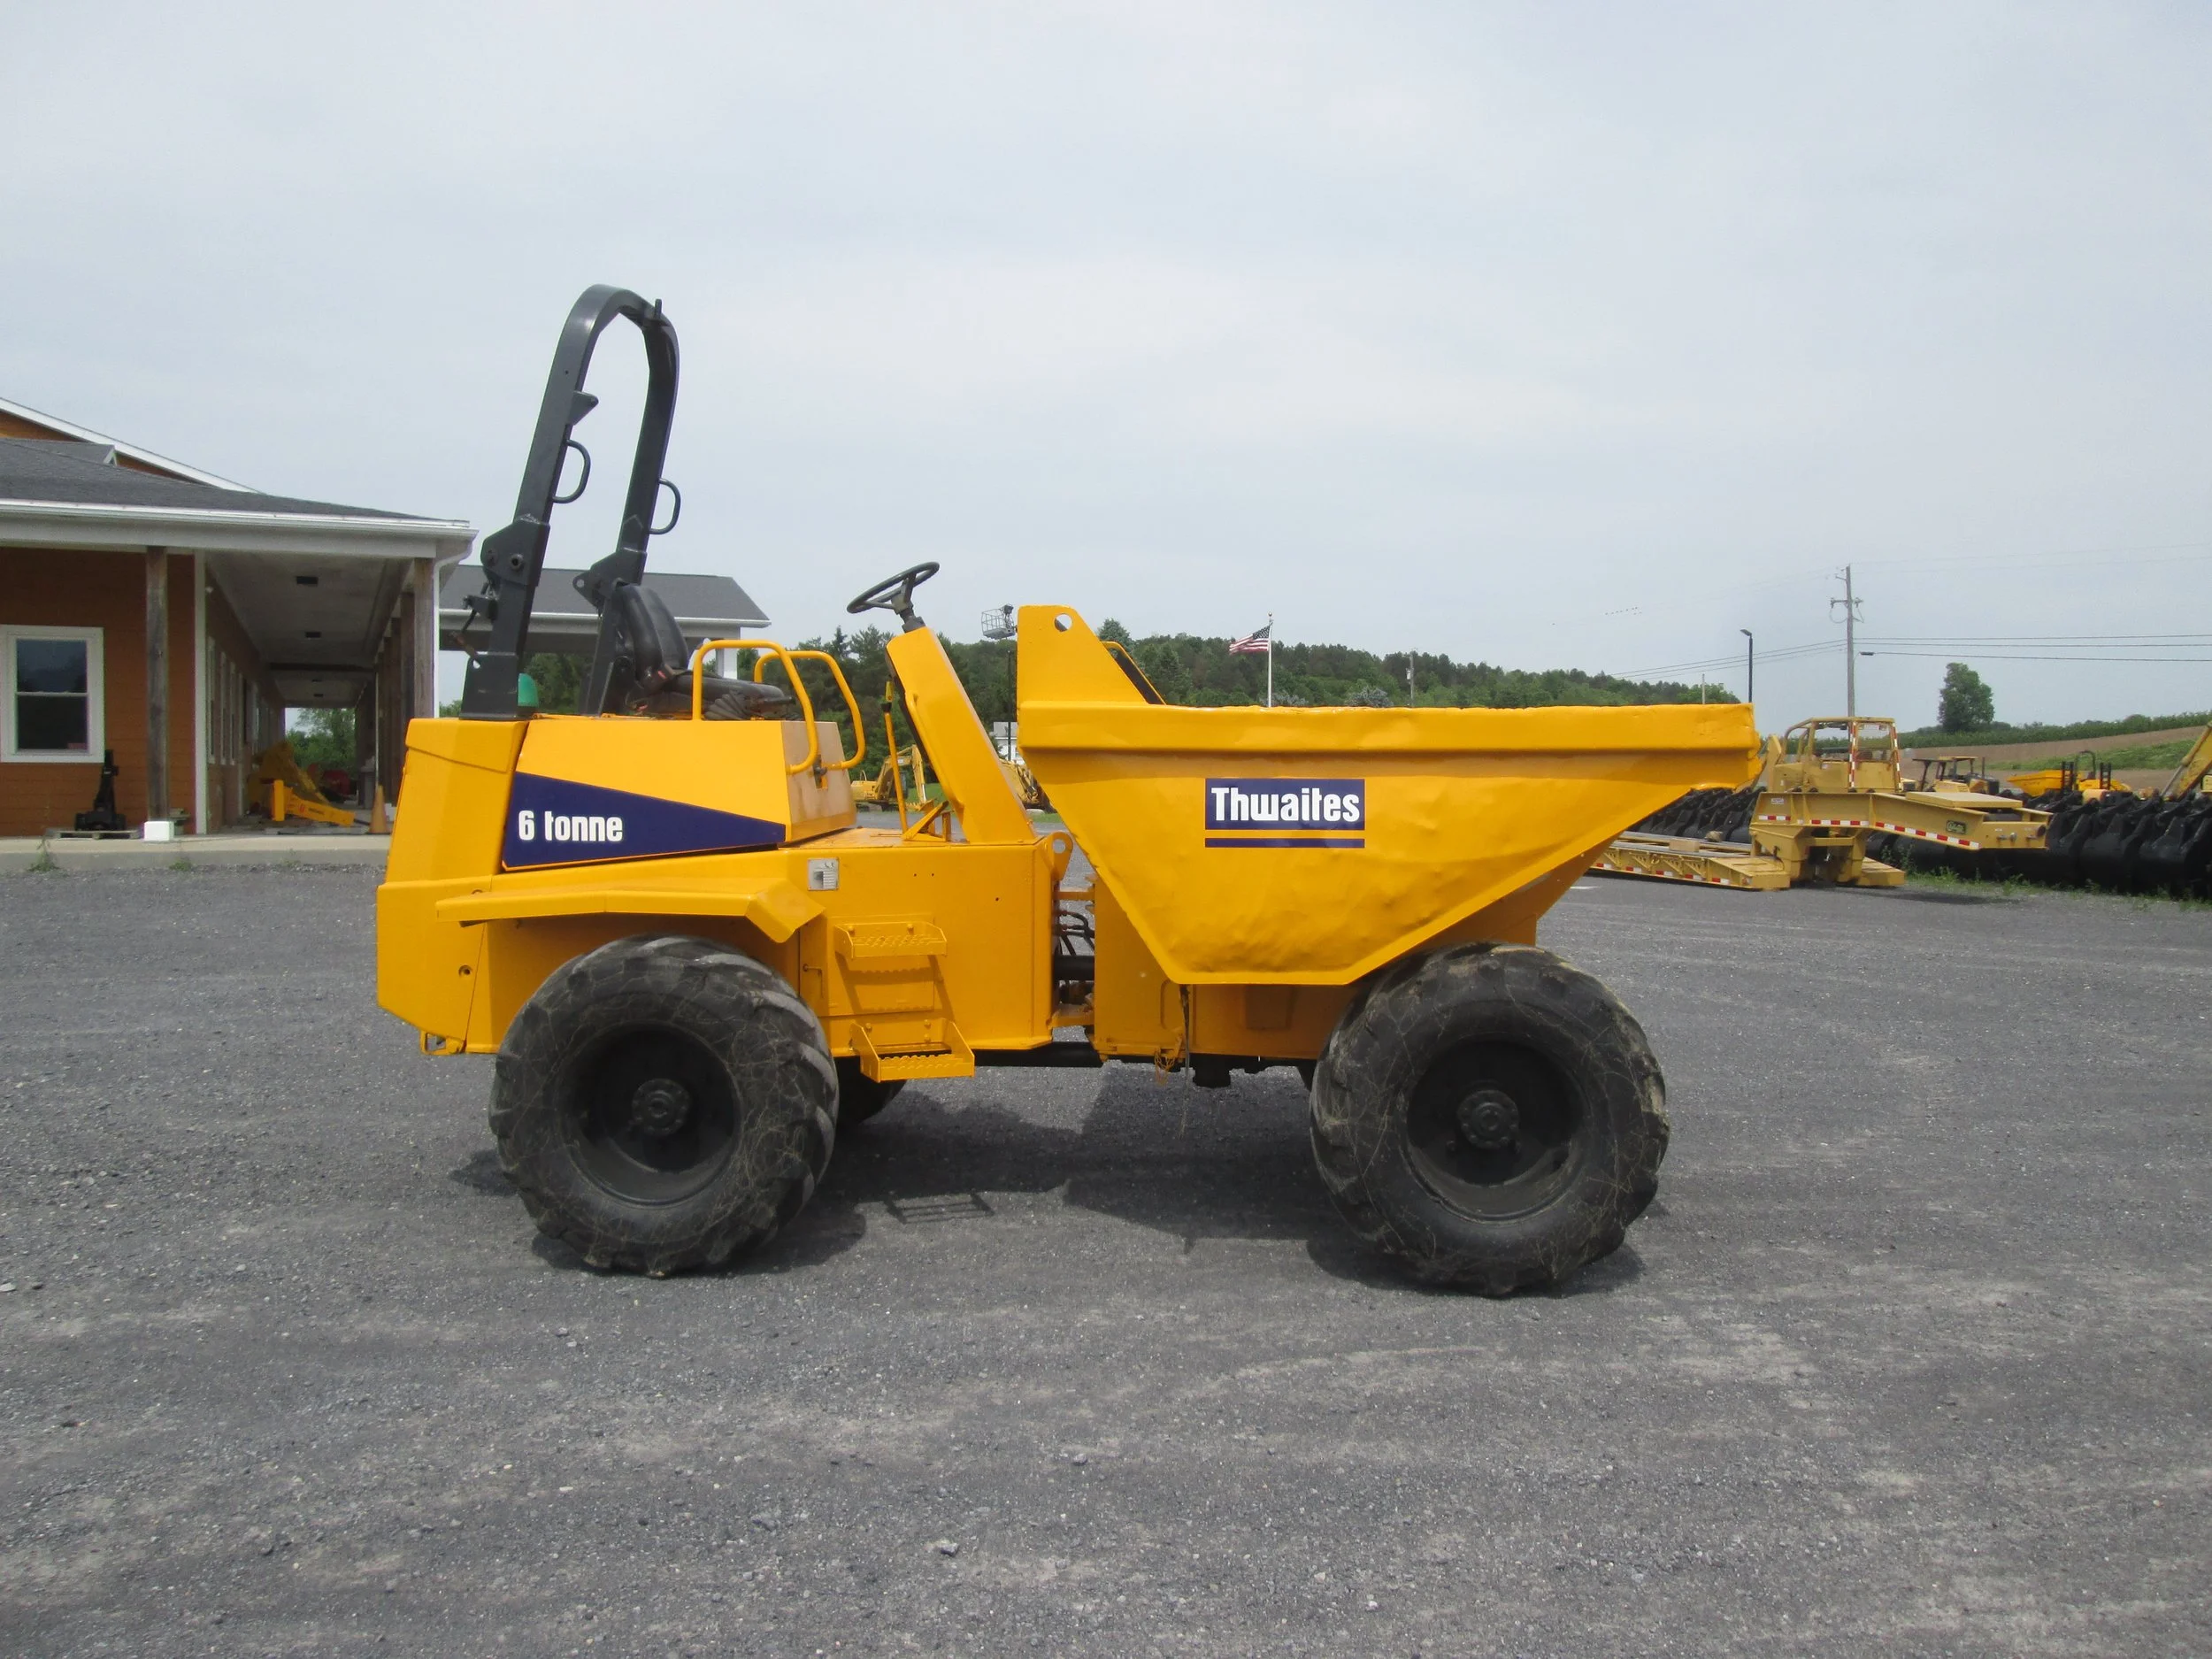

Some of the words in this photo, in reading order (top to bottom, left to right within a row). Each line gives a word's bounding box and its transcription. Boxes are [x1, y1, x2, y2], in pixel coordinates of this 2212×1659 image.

[1211, 787, 1360, 823] Thwaites
[518, 810, 535, 841] 6
[544, 810, 623, 842] tonne
